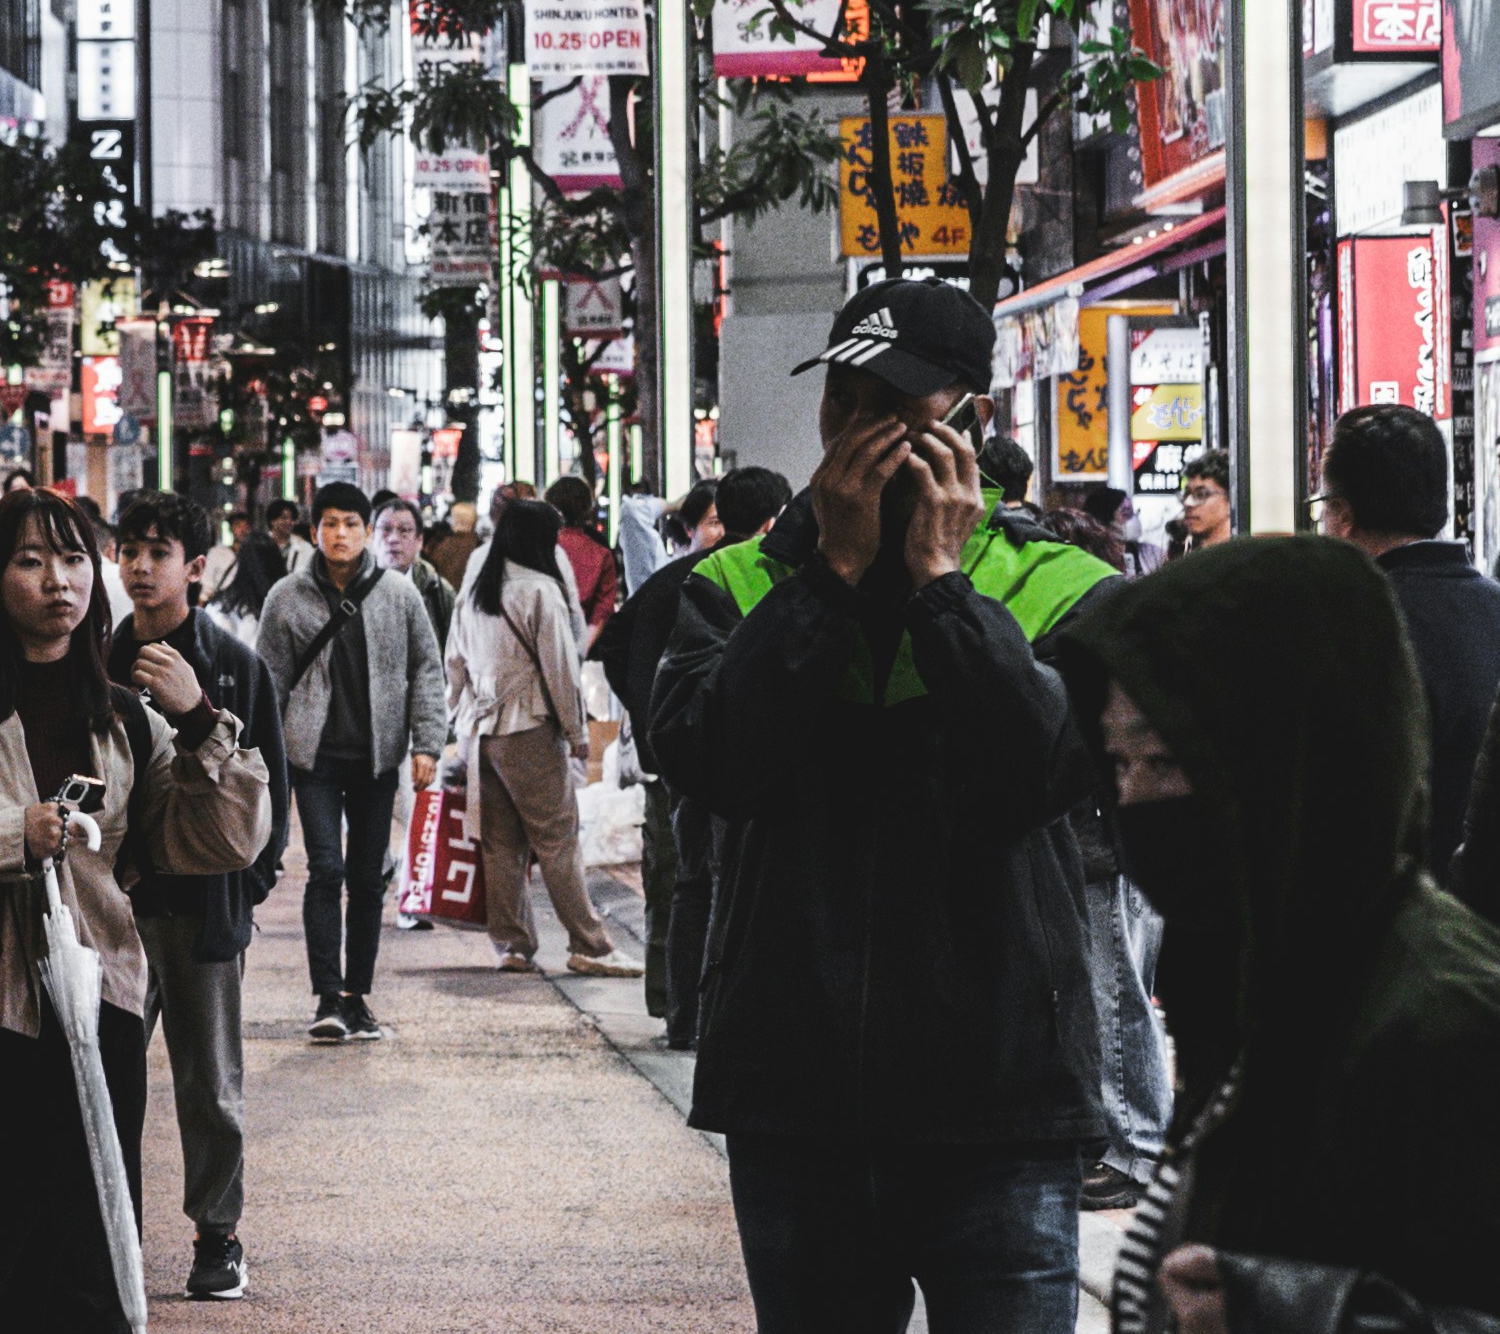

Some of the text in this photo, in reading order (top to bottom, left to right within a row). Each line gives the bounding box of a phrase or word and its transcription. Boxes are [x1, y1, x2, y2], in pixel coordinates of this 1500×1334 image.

[533, 0, 592, 21] SHINJUKU
[533, 27, 641, 51] 10.25 OPEN
[893, 120, 930, 208] 鉄板焼
[930, 226, 965, 246] 4F
[851, 323, 898, 340] adidas
